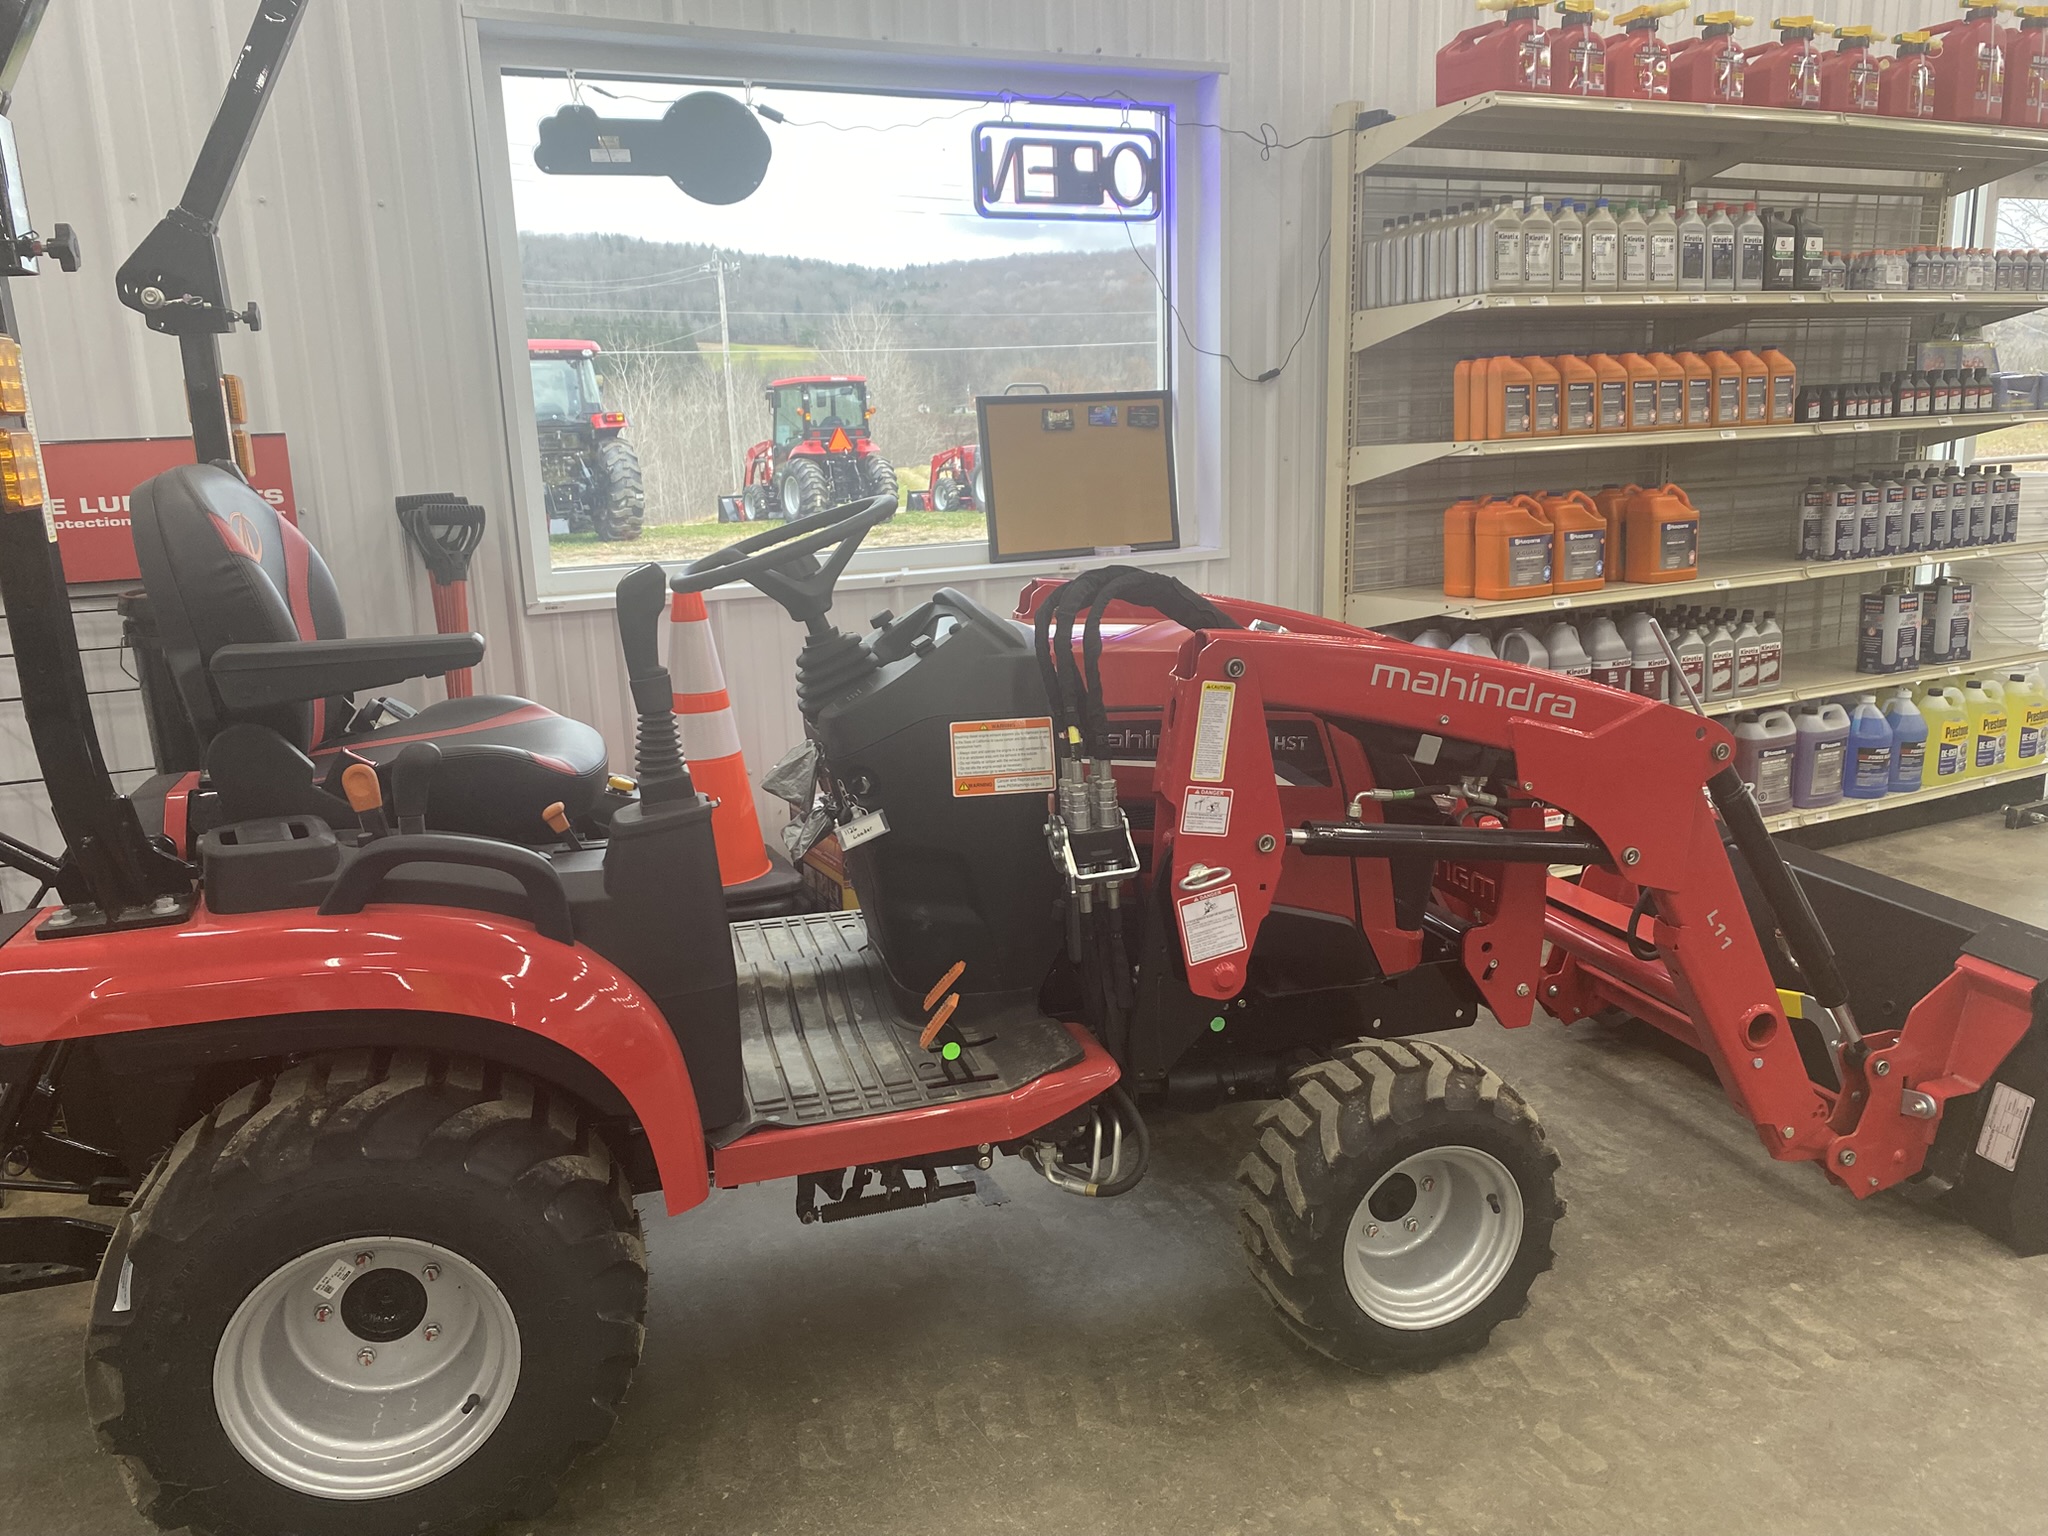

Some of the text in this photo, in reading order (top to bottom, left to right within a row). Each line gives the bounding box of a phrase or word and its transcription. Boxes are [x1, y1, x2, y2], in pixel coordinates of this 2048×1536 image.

[80, 496, 131, 513] LU
[55, 516, 132, 530] otection
[1371, 664, 1576, 719] mahindra
[1107, 729, 1161, 749] ahin
[1274, 735, 1308, 751] HST
